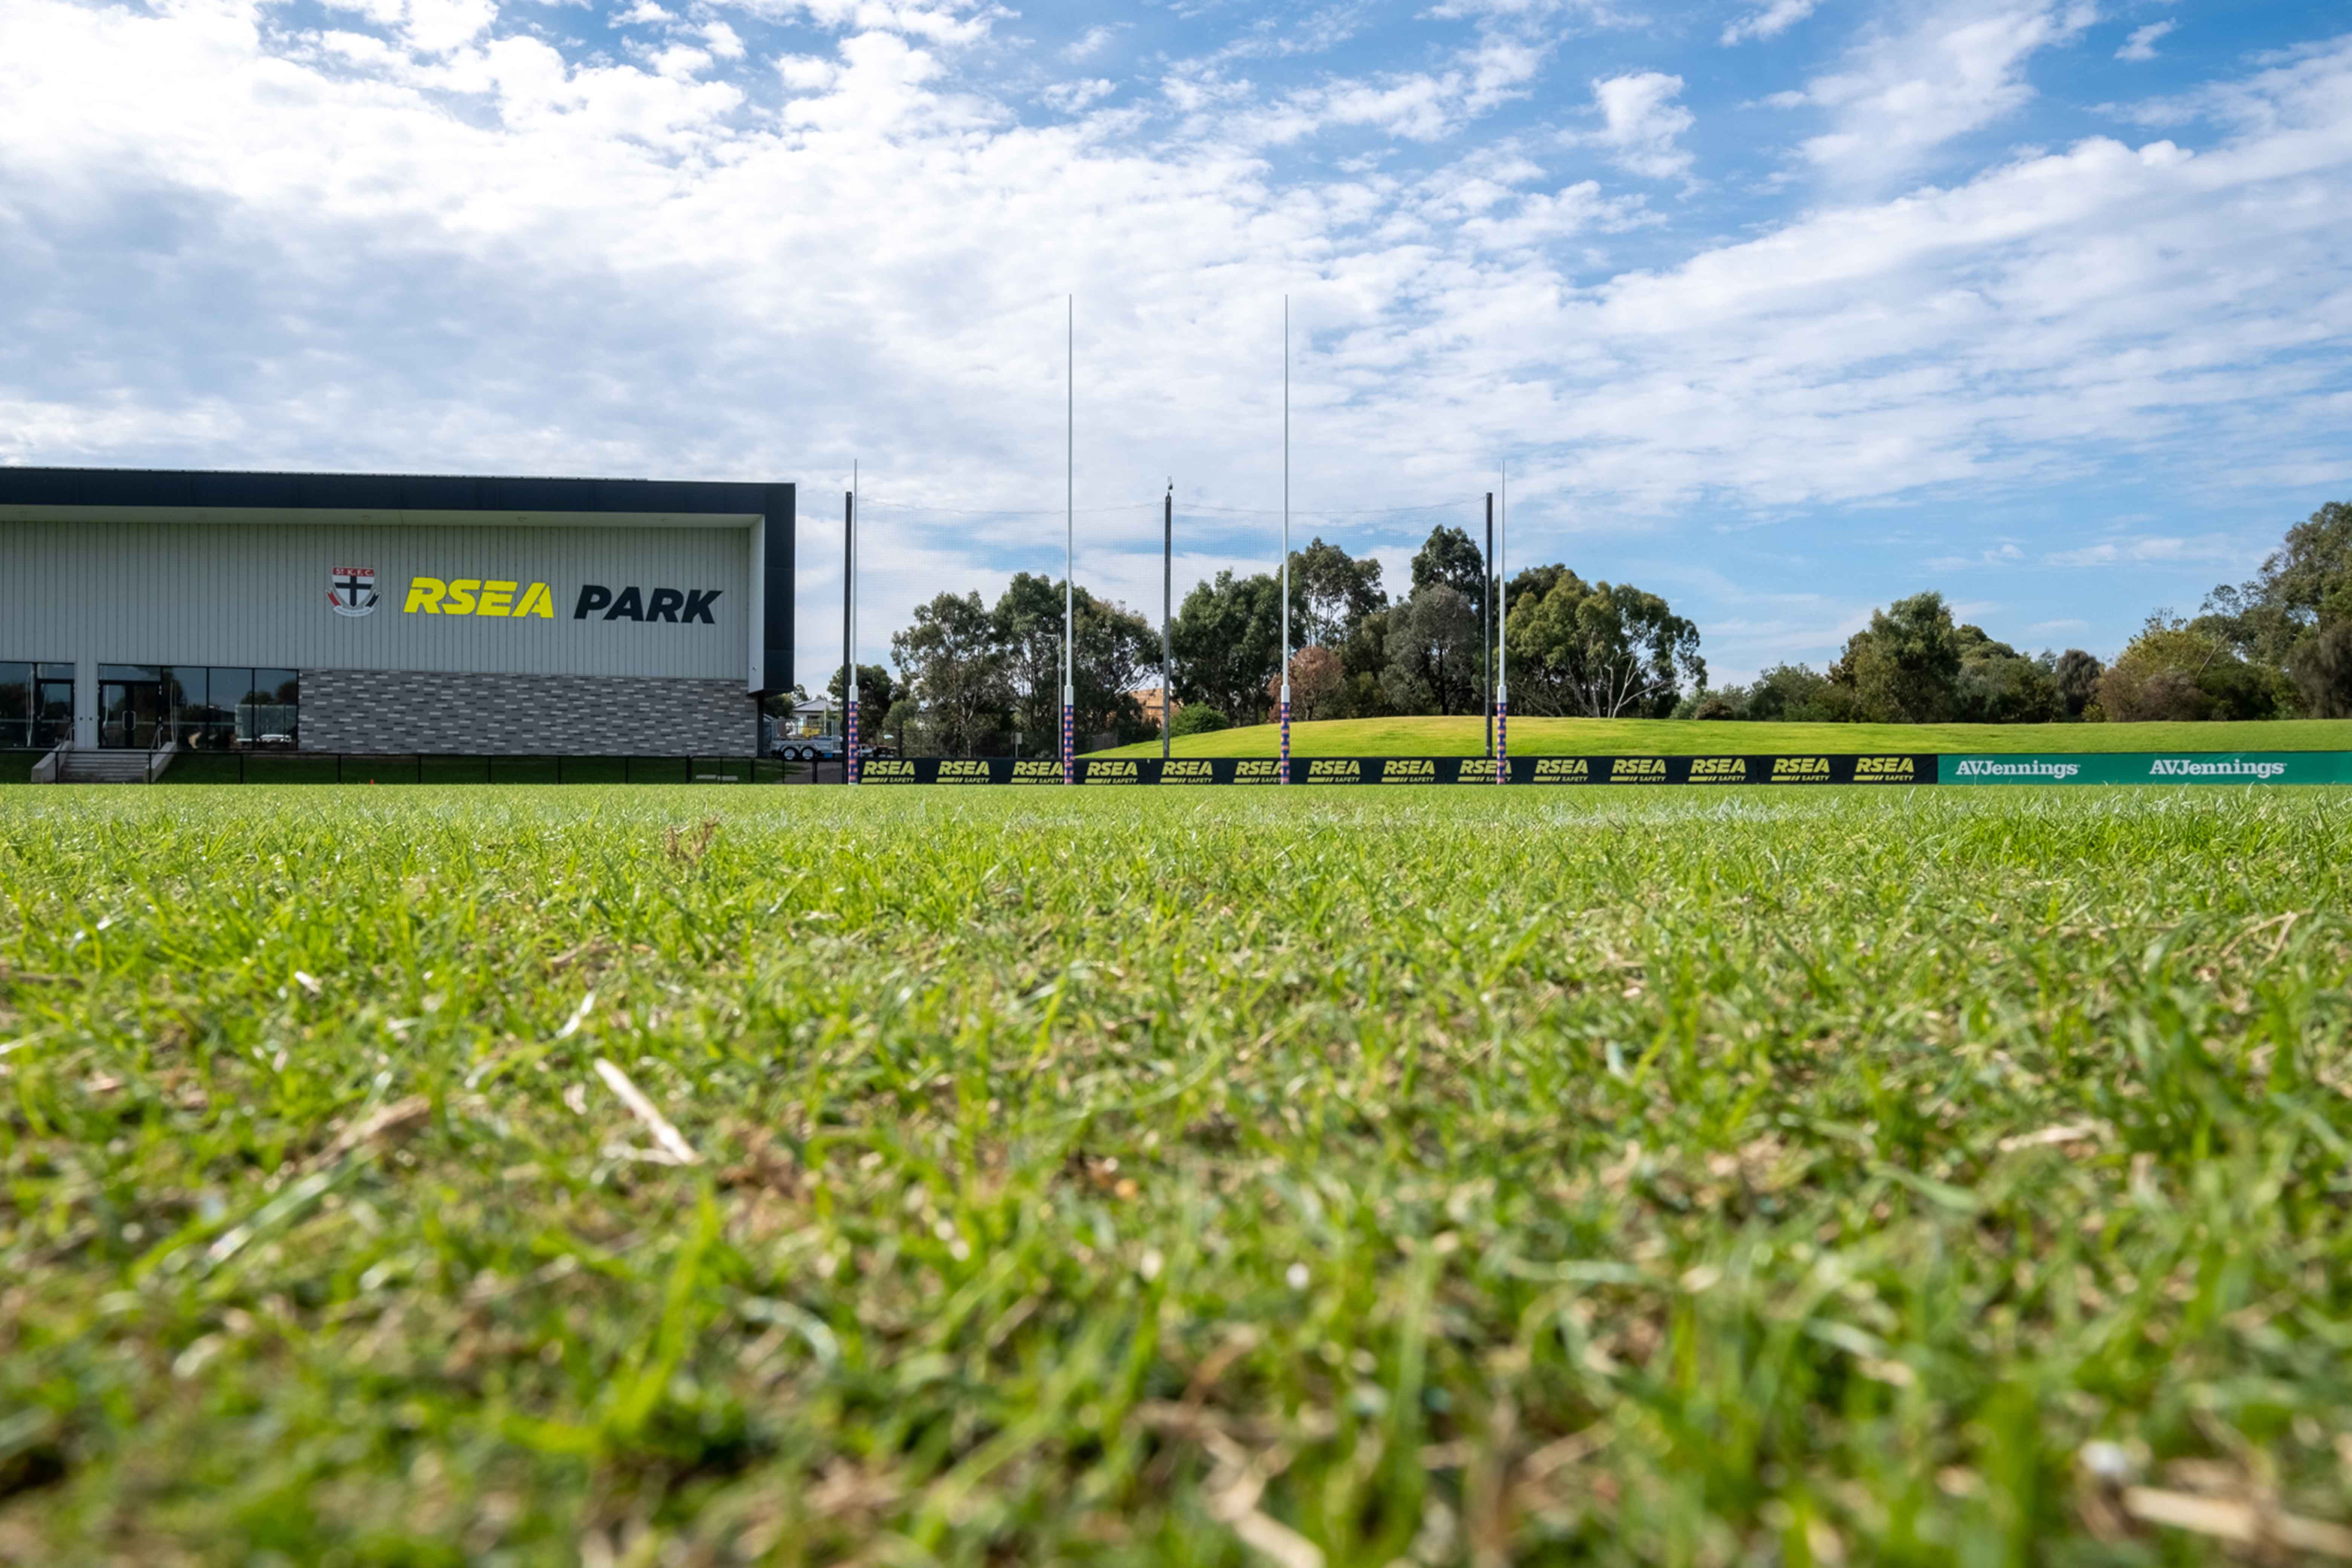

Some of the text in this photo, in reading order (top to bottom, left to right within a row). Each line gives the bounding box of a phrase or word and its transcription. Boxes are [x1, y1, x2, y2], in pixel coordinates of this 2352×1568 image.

[403, 577, 723, 624] RSEA PARK
[863, 761, 915, 775] RSEA
[938, 761, 989, 775] RSEA
[1013, 761, 1064, 776] RSEA
[1086, 761, 1138, 776] RSEA
[1161, 761, 1213, 775] RSEA
[1309, 760, 1360, 775] RSEA
[1383, 760, 1435, 775] RSEA
[1535, 759, 1588, 774] RSEA
[1612, 759, 1666, 774] RSEA
[1690, 758, 1746, 773] RSEA
[1773, 758, 1830, 773] RSEA
[1855, 757, 1915, 773] RSEA
[1955, 760, 2078, 779] AVJennings
[2149, 759, 2285, 778] AVJennings
